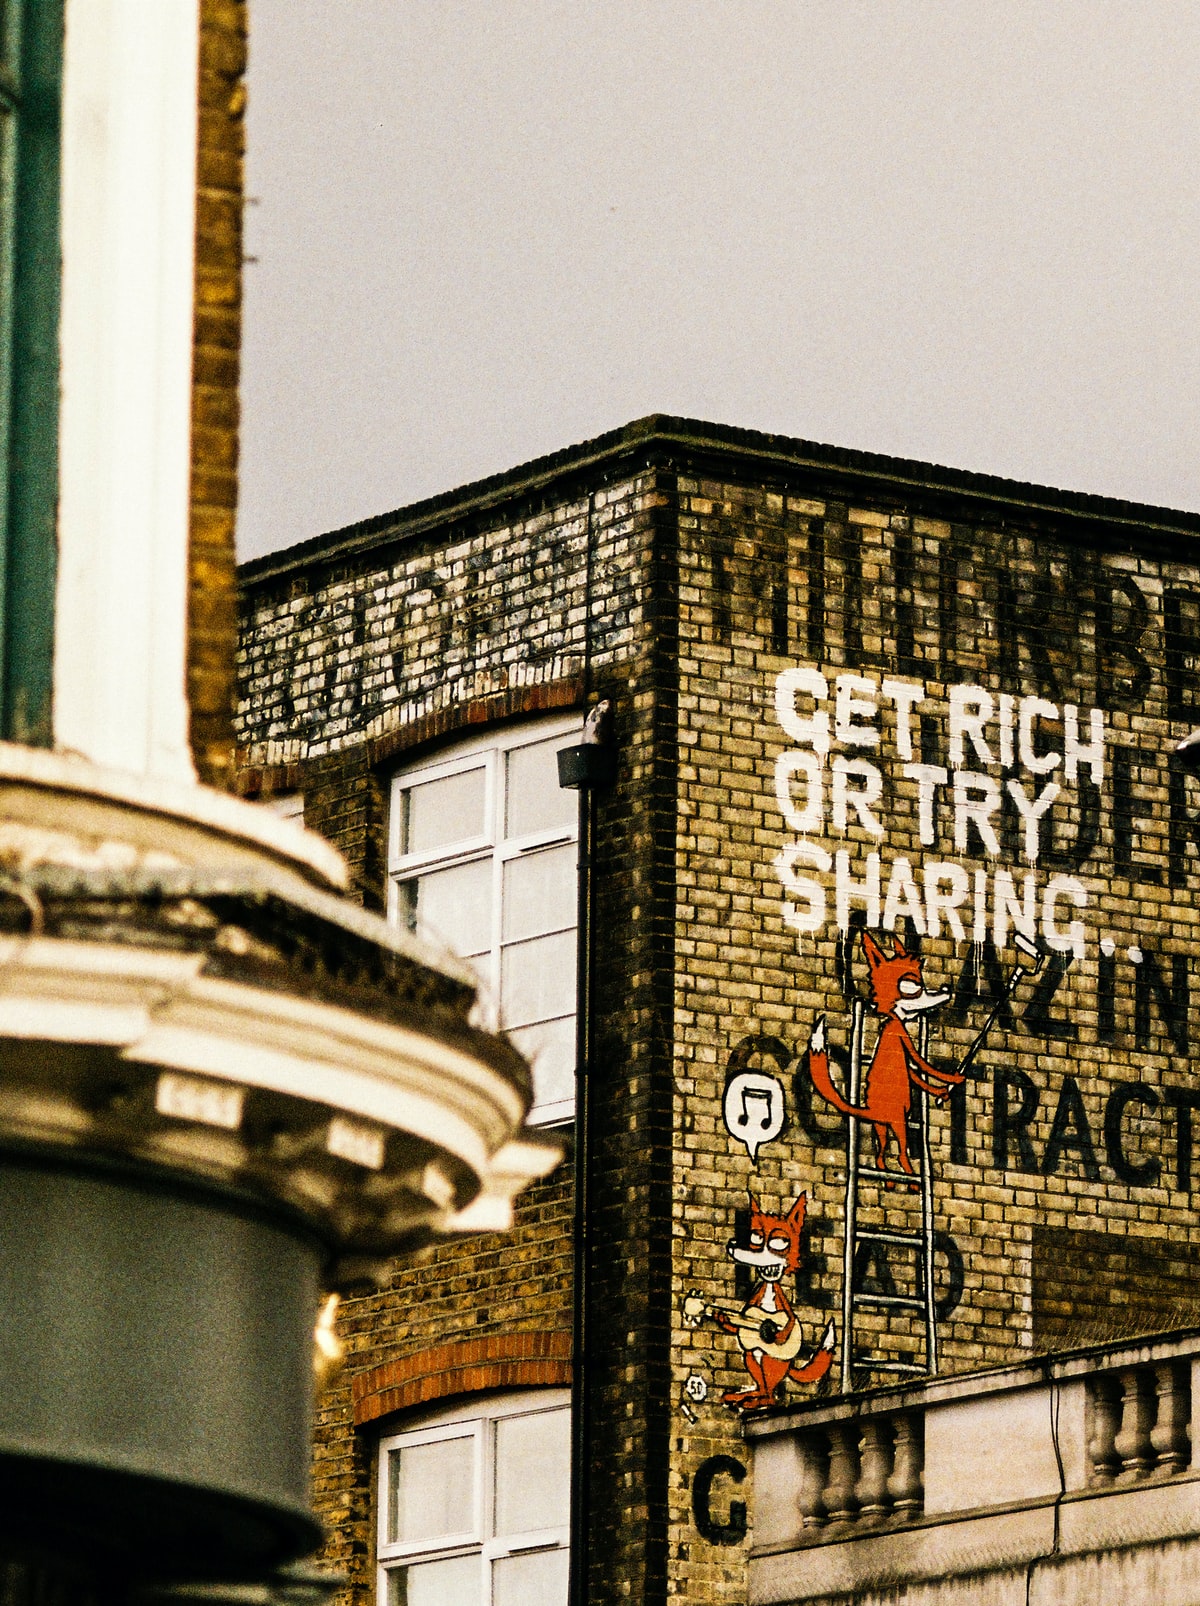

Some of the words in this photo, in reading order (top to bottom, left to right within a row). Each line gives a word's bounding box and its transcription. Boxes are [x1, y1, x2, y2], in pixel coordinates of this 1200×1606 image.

[775, 668, 924, 760] GET
[948, 683, 1104, 785] RICH
[775, 751, 883, 836] OR
[904, 763, 1060, 862] TRY
